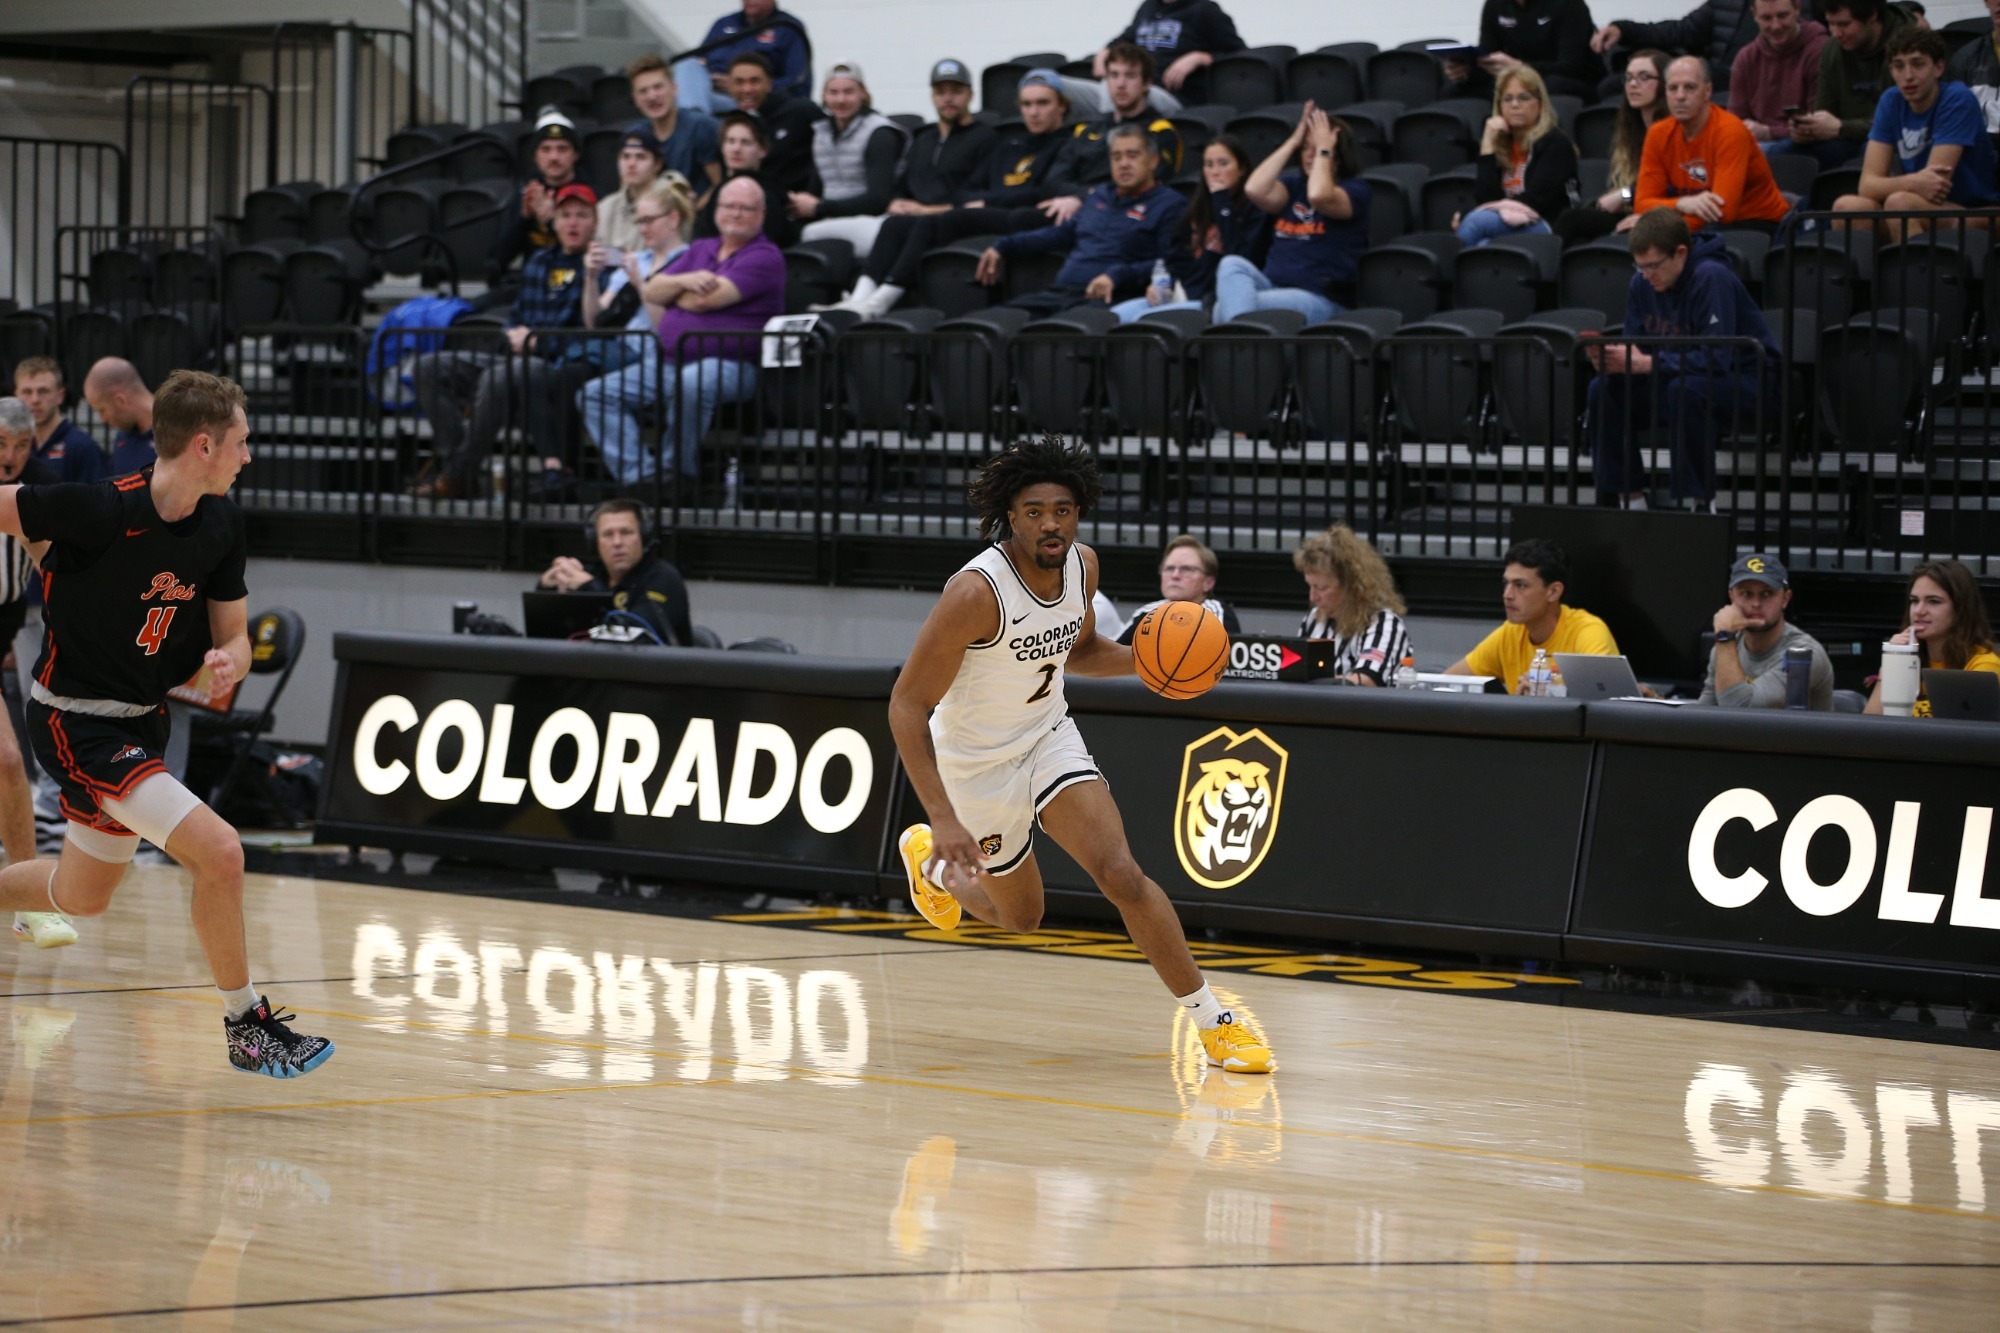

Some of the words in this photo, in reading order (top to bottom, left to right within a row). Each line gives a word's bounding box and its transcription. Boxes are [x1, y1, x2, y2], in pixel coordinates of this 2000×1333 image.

[141, 572, 196, 600] Pios
[136, 606, 178, 656] 4
[1009, 616, 1083, 650] COLORADO
[1224, 669, 1278, 680] AKTRONICS
[1230, 641, 1282, 672] OSS
[1025, 662, 1058, 705] 2
[354, 694, 874, 834] COLORADO
[1687, 787, 2000, 930] COLL
